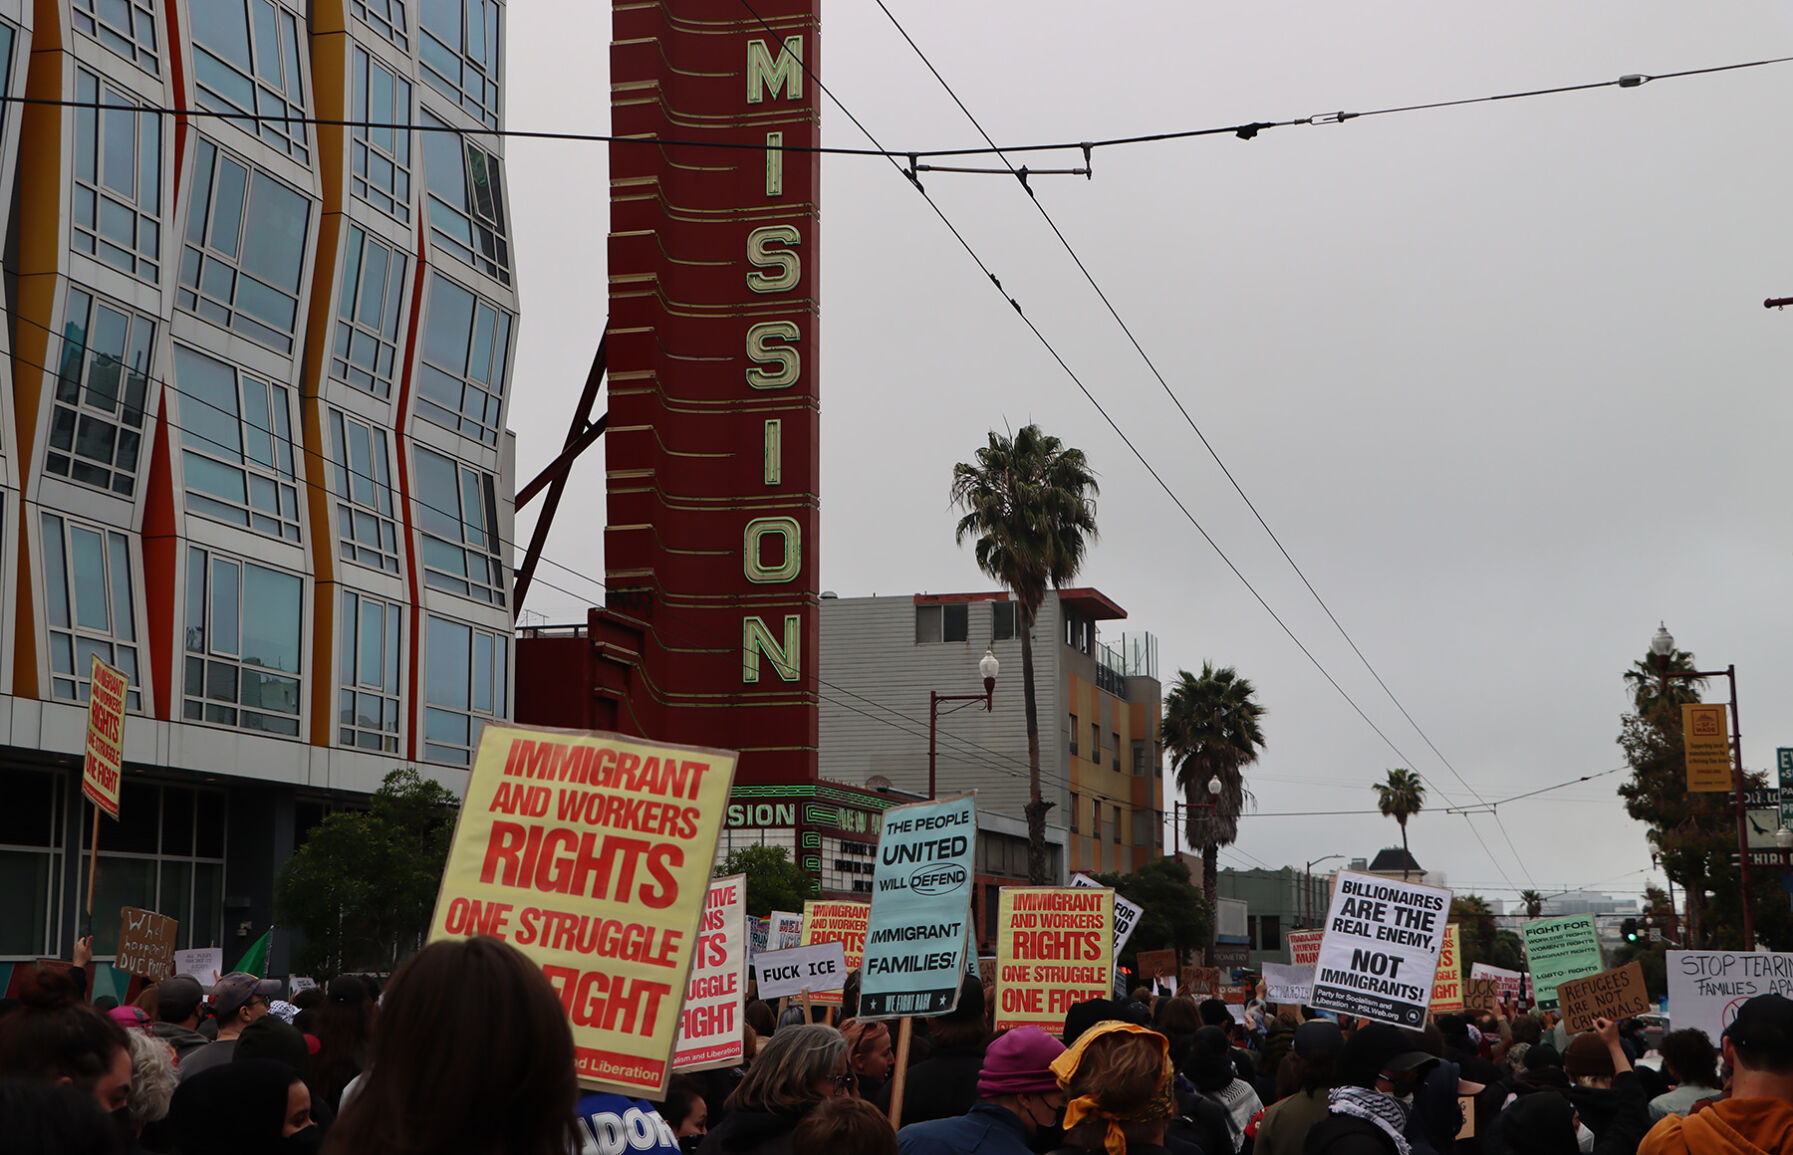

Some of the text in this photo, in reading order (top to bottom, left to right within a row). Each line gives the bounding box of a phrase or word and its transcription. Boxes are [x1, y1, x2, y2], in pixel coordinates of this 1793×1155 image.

[747, 35, 803, 683] MISSION
[92, 699, 120, 744] RIGHTS
[86, 750, 119, 795] ONE FIGHT
[504, 738, 711, 800] IMMIGRANT
[489, 782, 701, 840] AND WORKERS
[724, 803, 795, 826] SION
[886, 819, 912, 835] THE
[914, 811, 969, 831] PEOPLE
[882, 835, 967, 866] UNITED
[479, 820, 685, 909] RIGHTS
[880, 876, 907, 891] WILL
[910, 870, 966, 888] DEFEND
[1013, 893, 1104, 912] IMMIGRANT
[1342, 880, 1443, 911] BILLIONAIRES
[779, 919, 803, 934] MEL
[810, 919, 868, 931] AND WORKER
[1010, 914, 1104, 929] AND WORKERS
[1340, 897, 1388, 923] ARE
[1393, 906, 1436, 933] THE
[445, 897, 513, 942] ONE
[515, 907, 683, 968] STRUGGLE
[871, 922, 961, 944] IMMIGRANT
[1332, 917, 1371, 938] REAL
[1376, 928, 1436, 954] ENEMY,
[1526, 920, 1590, 936] FIGHT FOR
[1565, 930, 1592, 938] RIGHTS
[1012, 931, 1101, 961] RIGHTS
[1566, 938, 1594, 947] RIGHTS
[1570, 947, 1596, 955] RIGHTS
[119, 952, 145, 974] DUE
[763, 965, 800, 982] FUCK
[808, 960, 836, 976] ICE
[867, 951, 957, 975] FAMILIES!
[1002, 965, 1031, 982] ONE
[1034, 966, 1106, 984] STRUGGLE
[1350, 948, 1404, 979] NOT
[1567, 965, 1598, 974] RIGHTS
[1681, 954, 1736, 976] STOP
[687, 972, 737, 1001] UGGLE
[1320, 968, 1425, 1002] IMMIGRANTS!
[1431, 983, 1458, 1000] IGHT
[1462, 979, 1497, 997] UCK
[1564, 971, 1629, 1002] REFUGEES
[1694, 977, 1758, 996] FAMILIES
[1002, 988, 1043, 1013] ONE
[1316, 996, 1399, 1021] Liberation PSLWeb.org
[1317, 989, 1392, 1010] Party for Socialism and
[1568, 989, 1622, 1017] ARE NOT
[1572, 996, 1644, 1030] CRIMINALS
[706, 1046, 741, 1058] Liberation
[590, 1058, 660, 1081] Liberation
